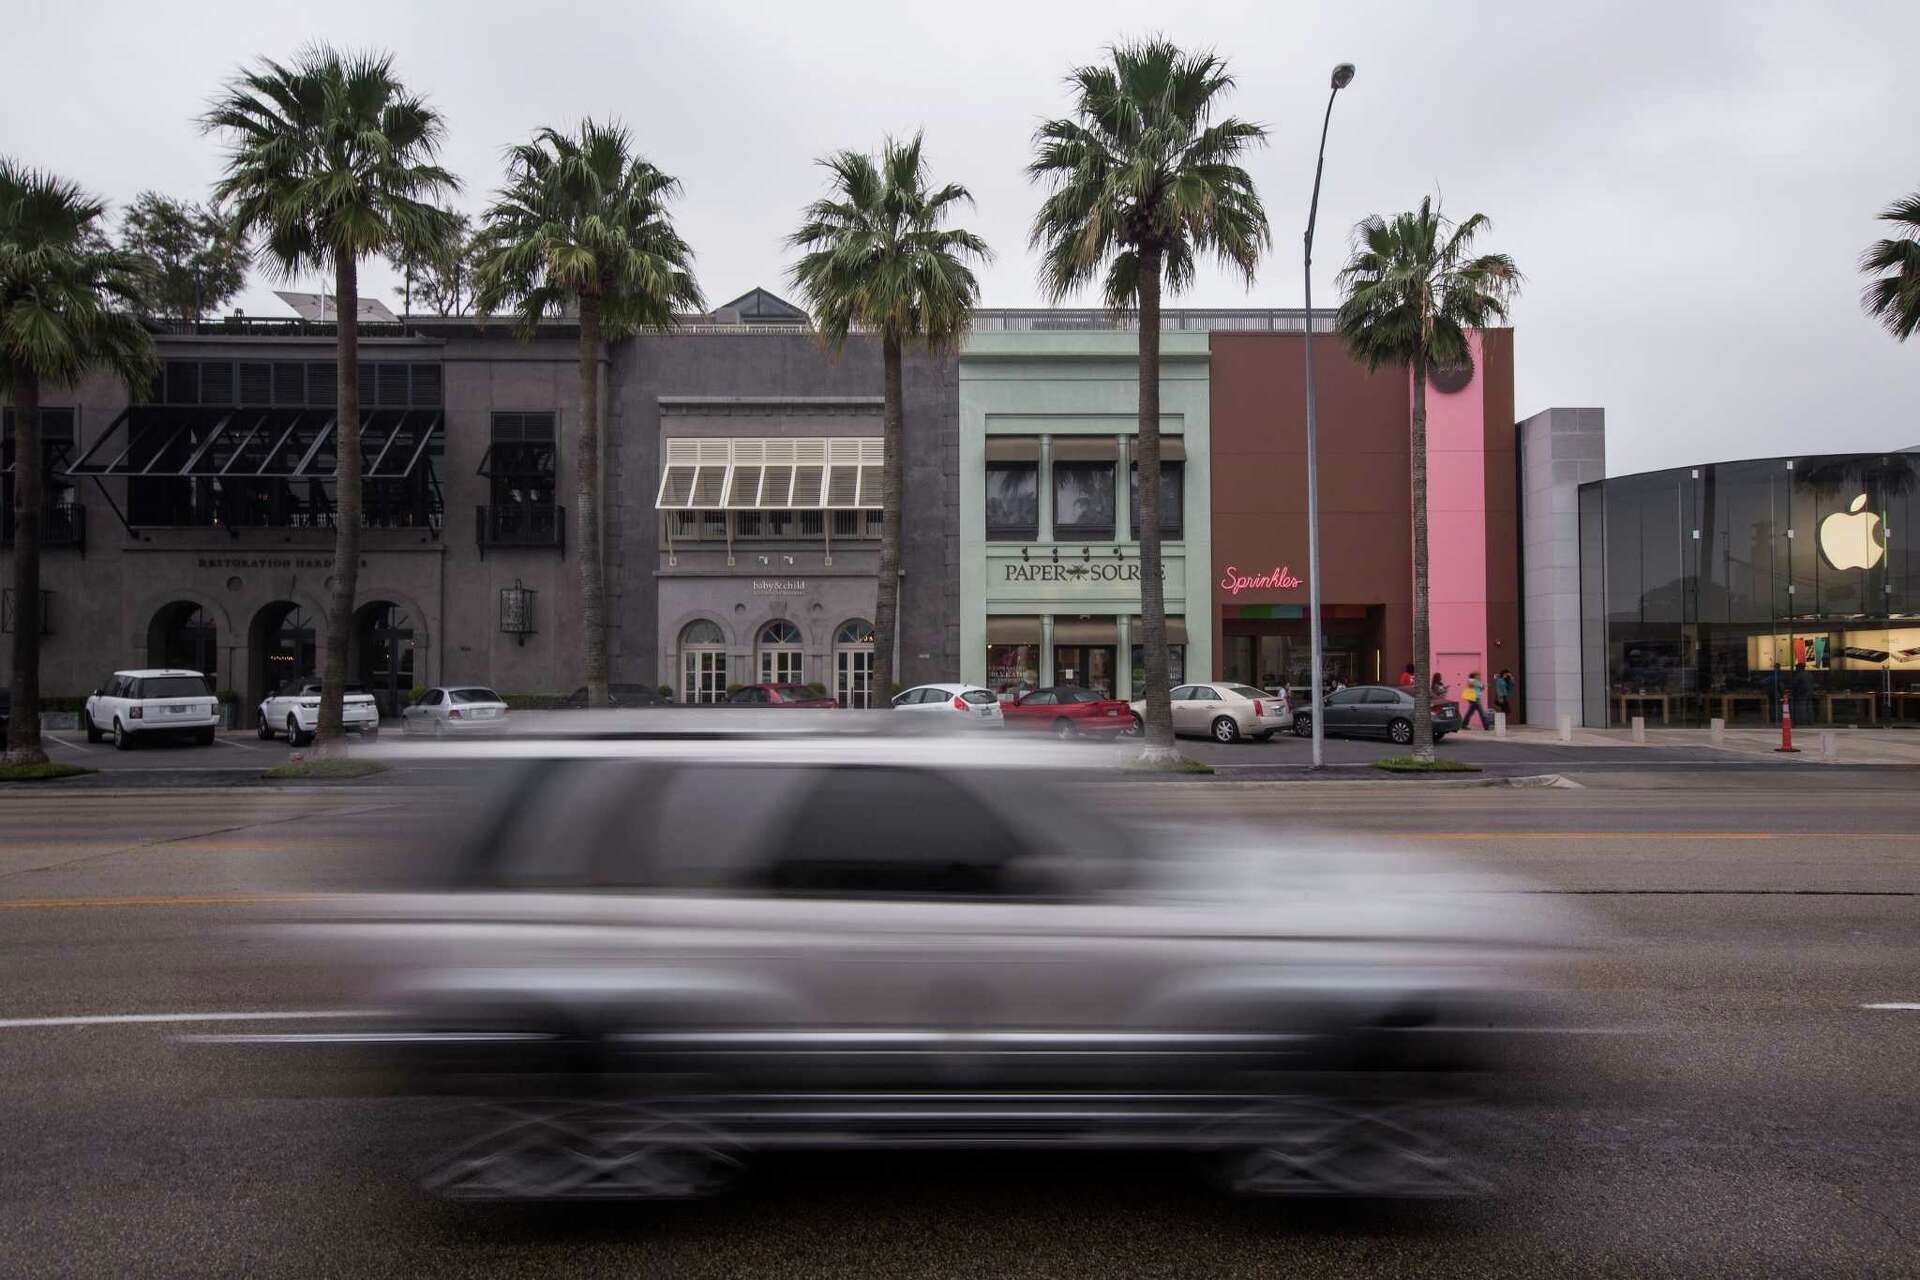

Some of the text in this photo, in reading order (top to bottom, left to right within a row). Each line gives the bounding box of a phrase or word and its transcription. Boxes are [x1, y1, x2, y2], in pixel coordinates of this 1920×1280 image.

[1005, 564, 1166, 581] PAPER SOURE
[1220, 566, 1304, 595] Sprinkles
